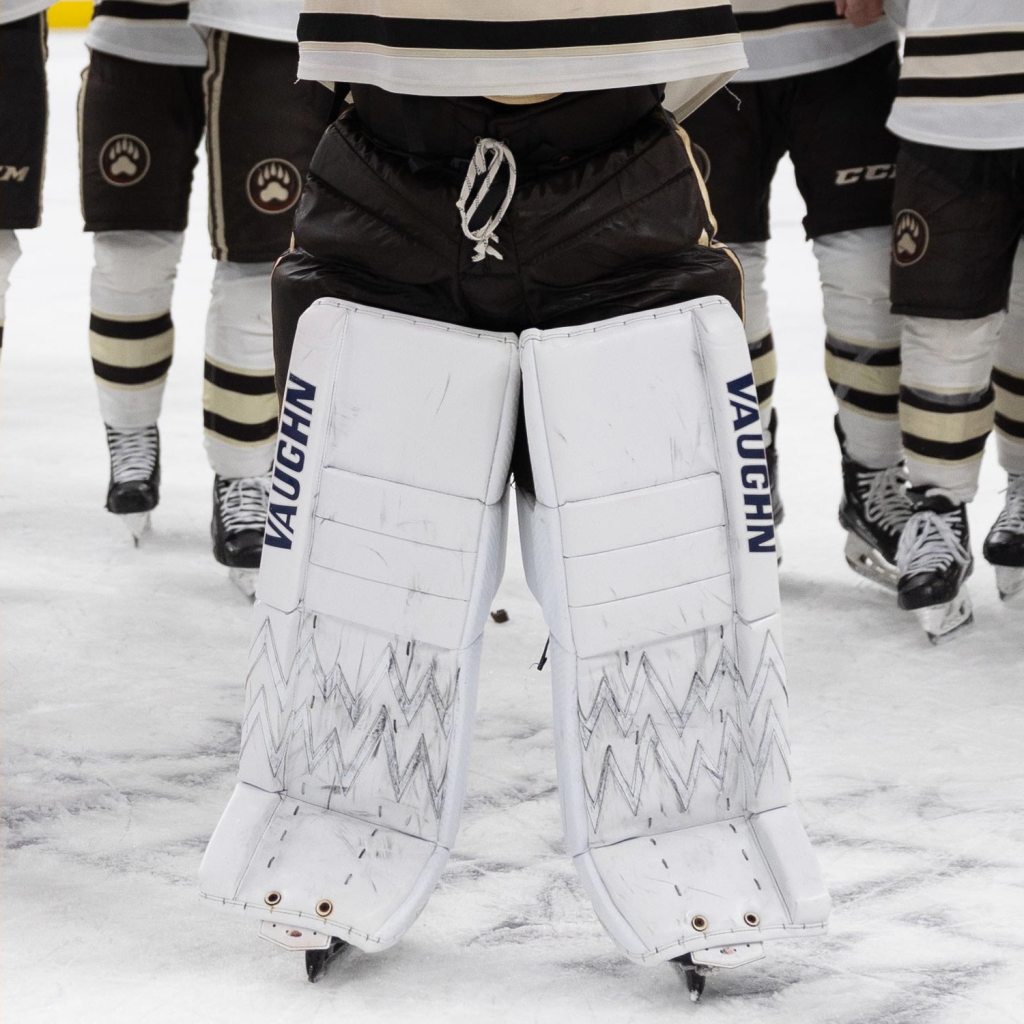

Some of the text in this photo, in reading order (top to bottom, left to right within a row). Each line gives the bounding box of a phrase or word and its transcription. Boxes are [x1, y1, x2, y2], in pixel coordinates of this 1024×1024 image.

[835, 163, 896, 185] CC
[264, 372, 317, 550] VAUGHN
[726, 372, 777, 553] VAUGHN
